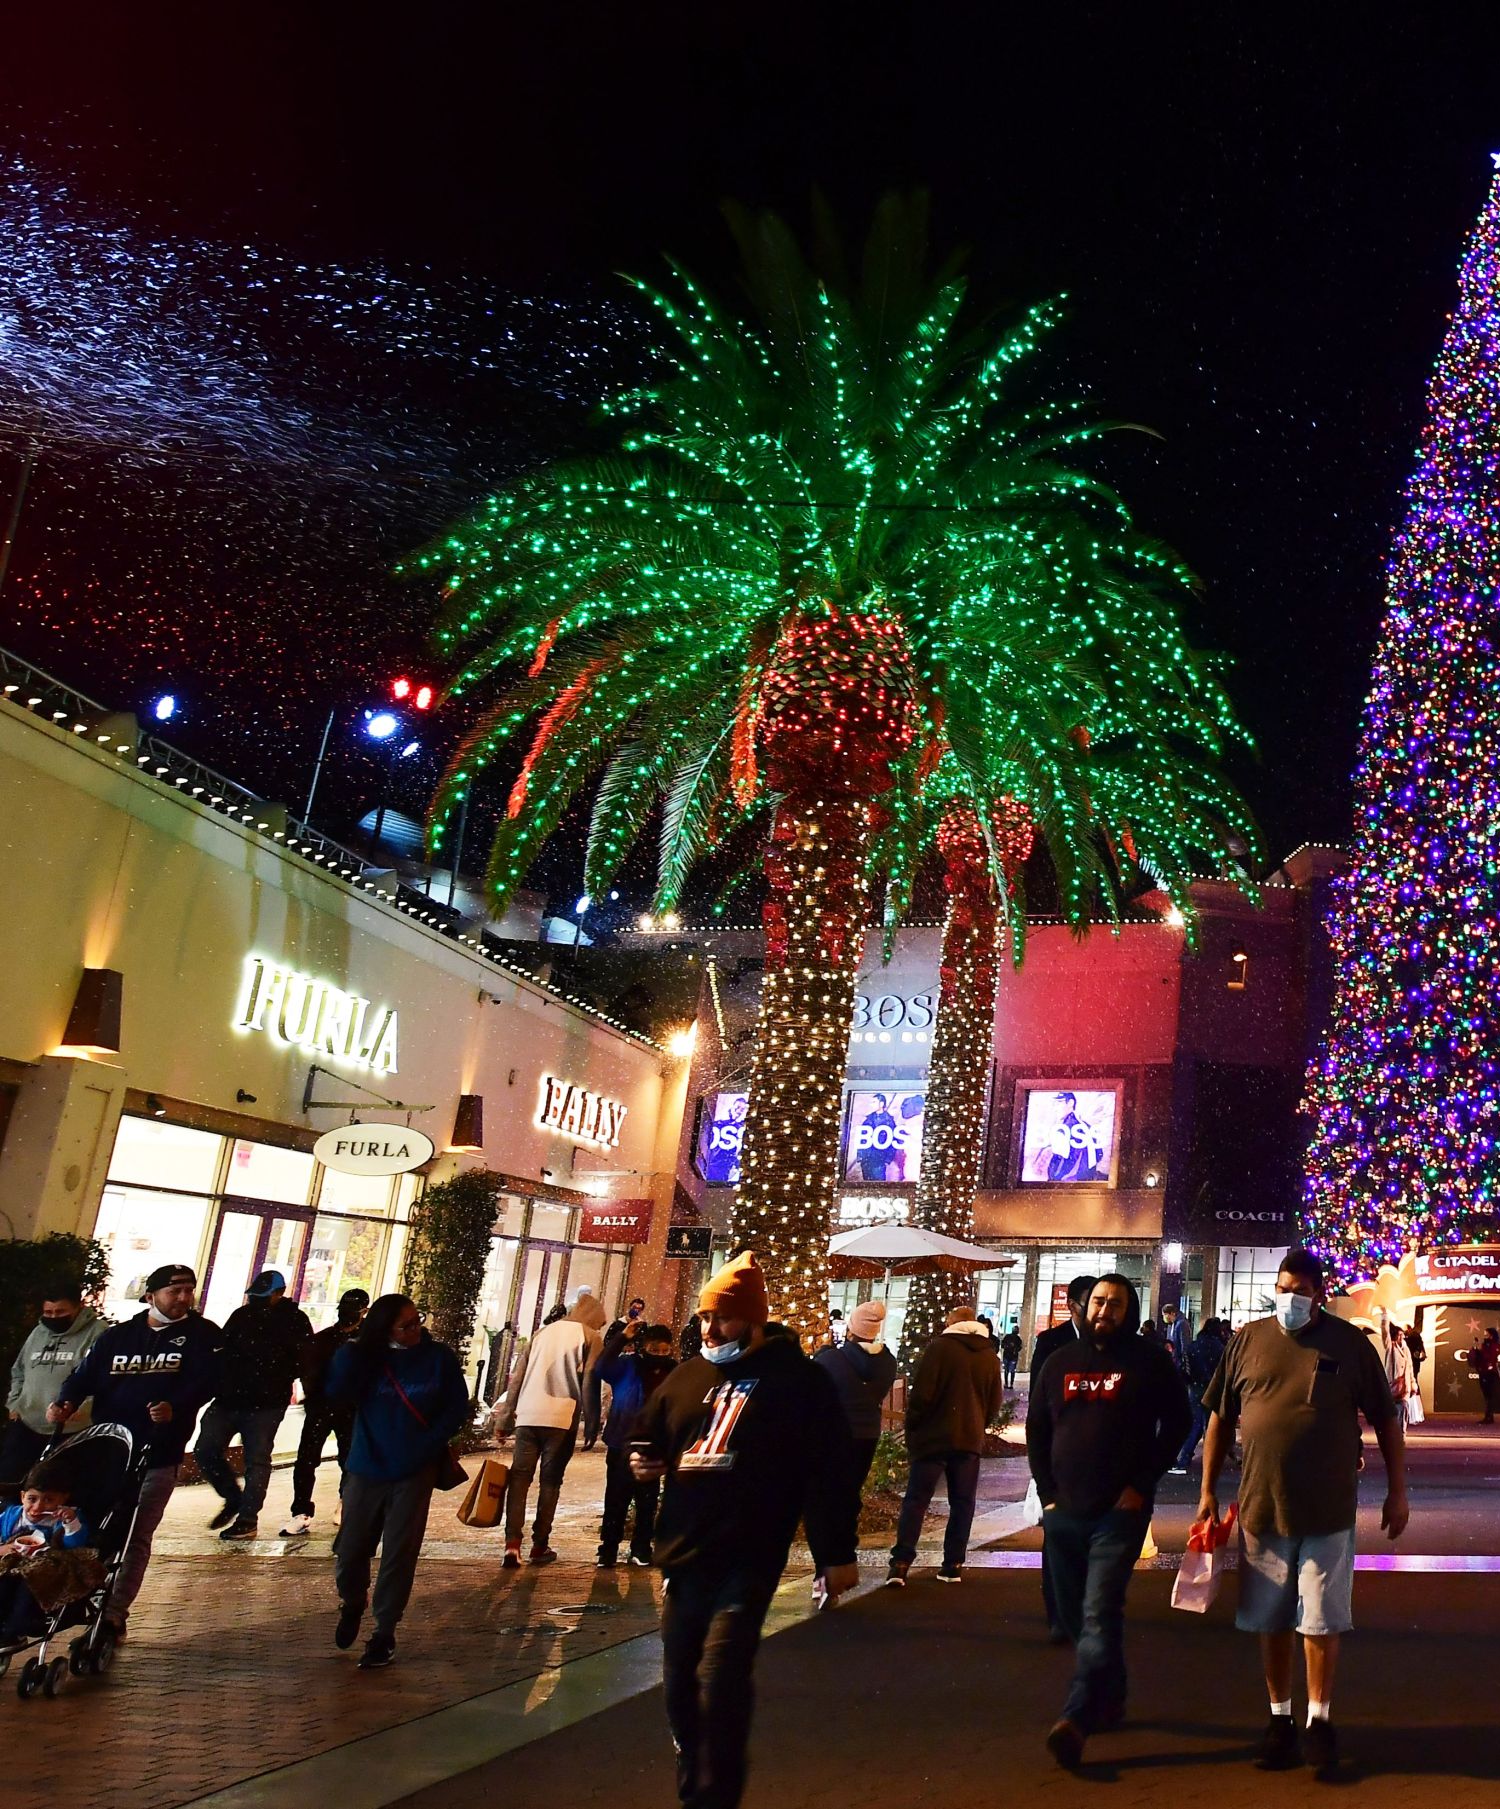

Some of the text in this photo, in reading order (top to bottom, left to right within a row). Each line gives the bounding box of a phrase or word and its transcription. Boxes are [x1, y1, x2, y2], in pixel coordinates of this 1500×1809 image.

[237, 957, 398, 1073] FURLA
[853, 994, 933, 1029] BOS
[540, 1077, 628, 1147] BALLY
[854, 1125, 912, 1149] BOS
[334, 1140, 411, 1158] FURLA
[840, 1196, 910, 1219] BOSS
[1215, 1210, 1285, 1222] COACH
[592, 1215, 639, 1226] BALLY
[1433, 1255, 1498, 1267] CITADEL
[1416, 1274, 1467, 1292] Tallest
[112, 1352, 183, 1371] RAMS
[1068, 1378, 1115, 1392] Lev's
